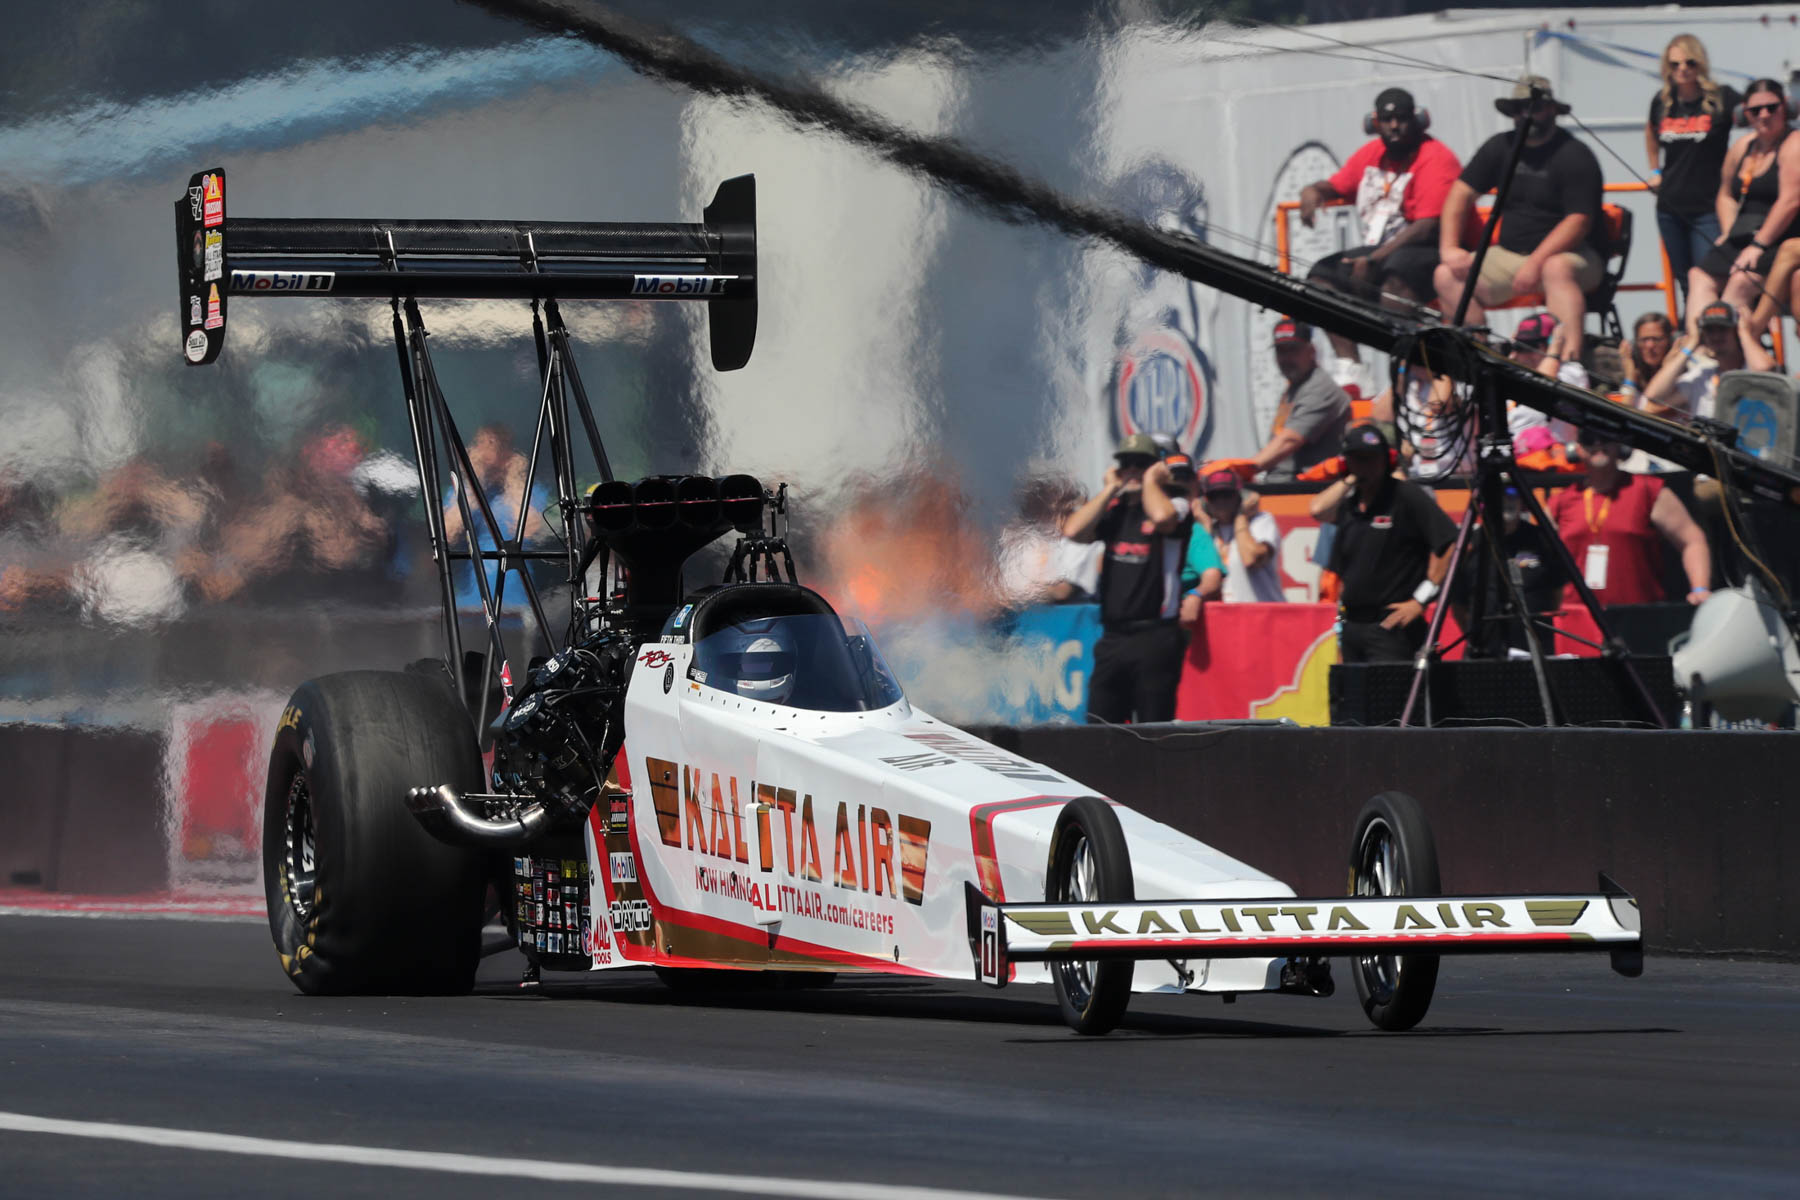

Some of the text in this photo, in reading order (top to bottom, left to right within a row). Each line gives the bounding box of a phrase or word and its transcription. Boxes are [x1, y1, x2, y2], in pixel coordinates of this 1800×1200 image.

[232, 274, 303, 290] Mobil
[635, 278, 708, 293] Mobil
[511, 702, 536, 721] MSD
[833, 801, 897, 900] AIR
[611, 856, 629, 879] Mobil
[695, 864, 718, 894] NOW
[609, 899, 652, 932] DAYCO
[1081, 902, 1511, 935] KALITTA AIR
[593, 951, 612, 965] TOOLS
